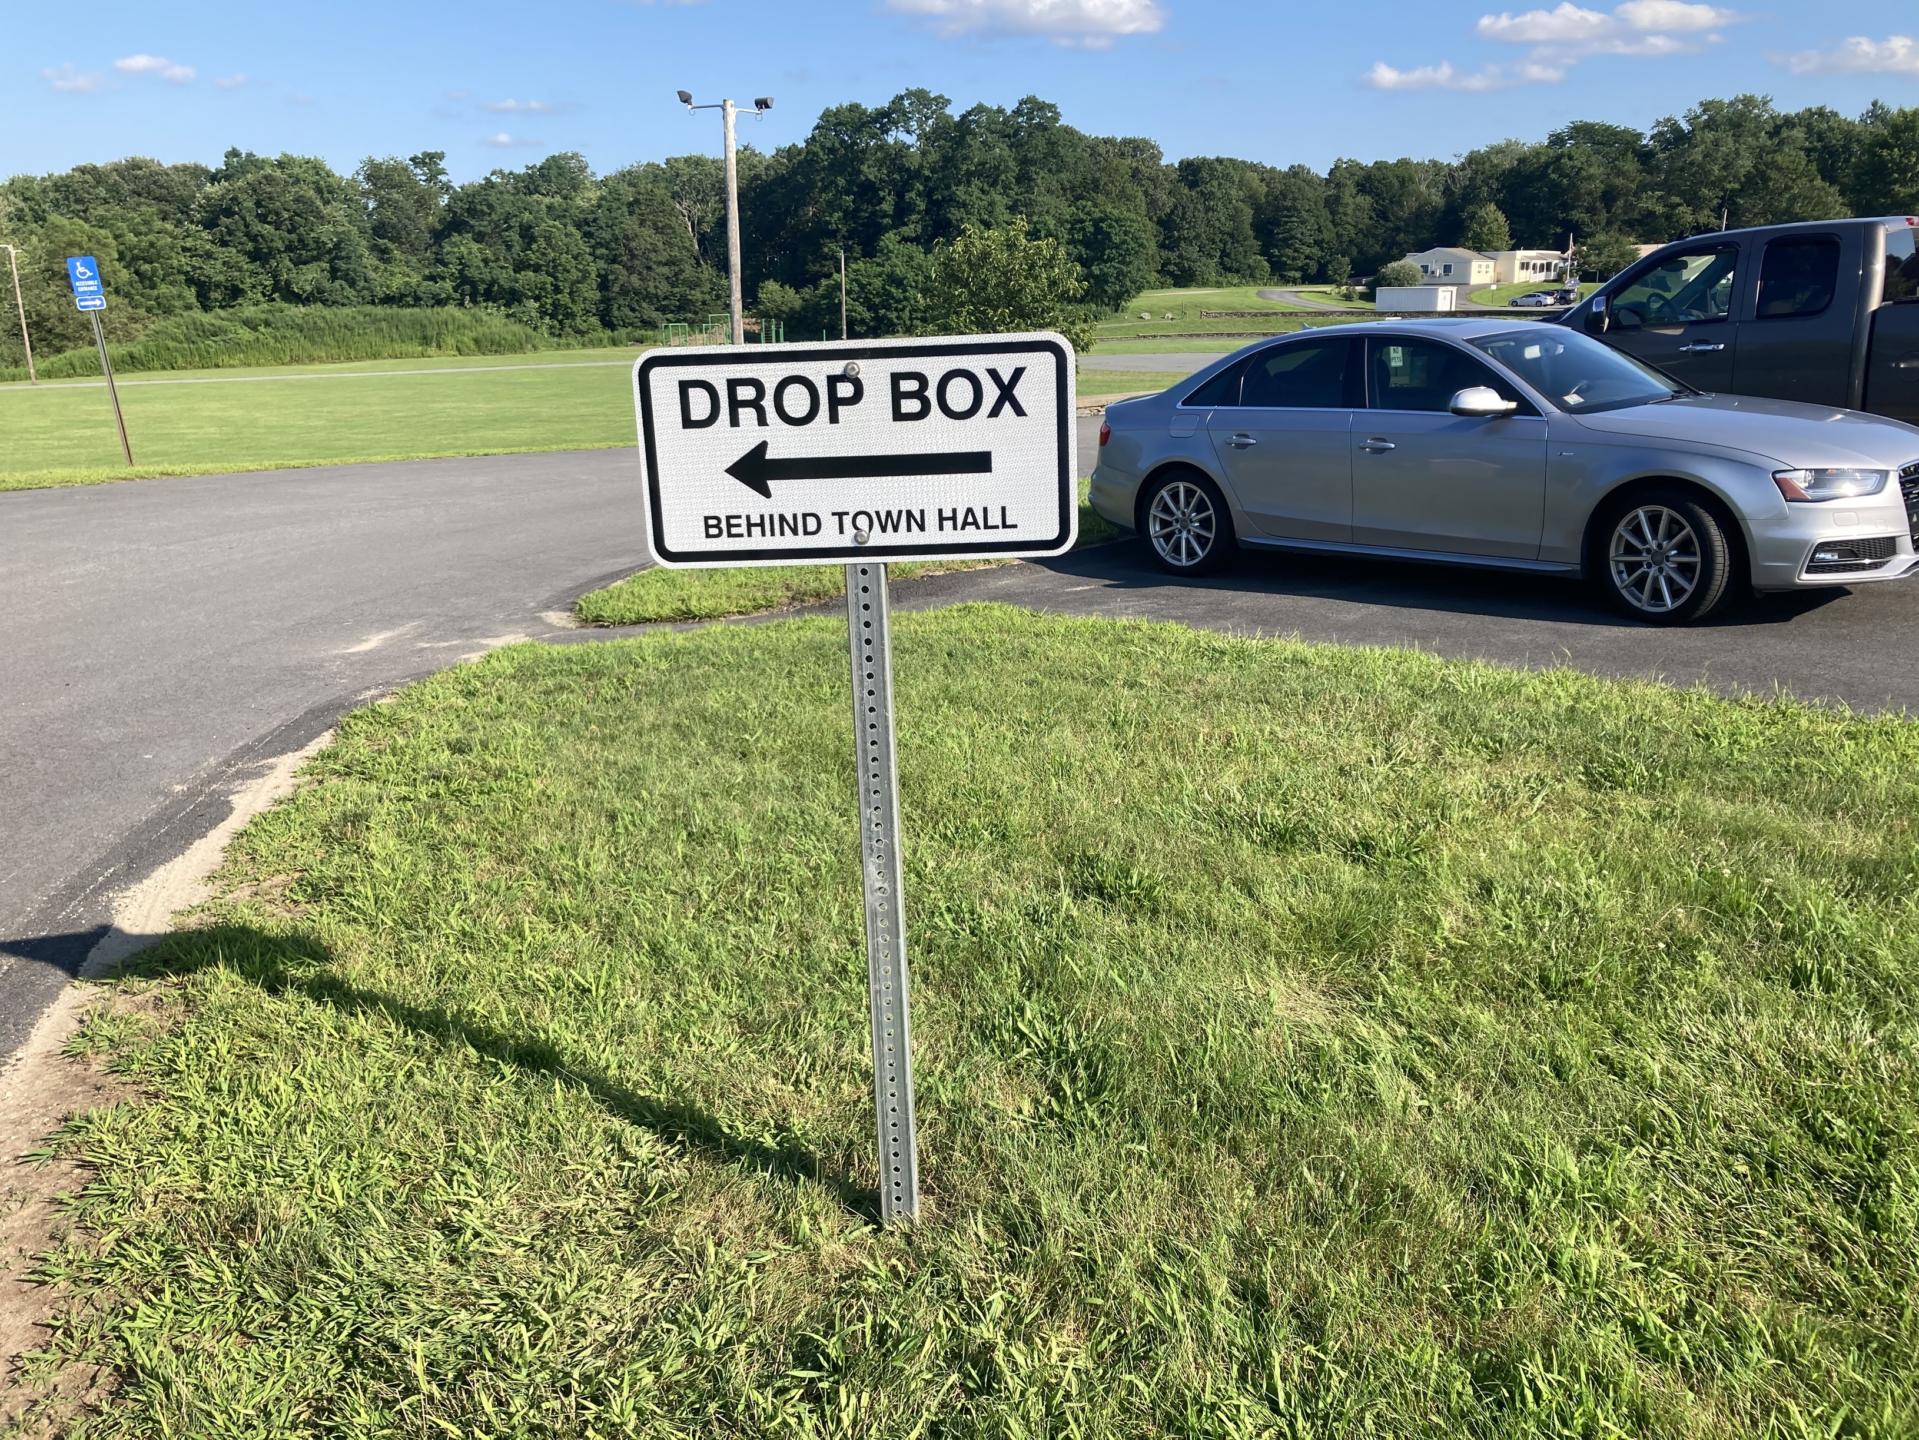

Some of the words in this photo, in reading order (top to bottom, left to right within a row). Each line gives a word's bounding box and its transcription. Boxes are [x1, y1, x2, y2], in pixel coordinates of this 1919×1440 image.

[679, 374, 863, 429] DROP
[891, 367, 1027, 421] BOX
[704, 513, 821, 538] BEHIND
[833, 510, 926, 536] TOWN
[938, 506, 1017, 531] HALL
